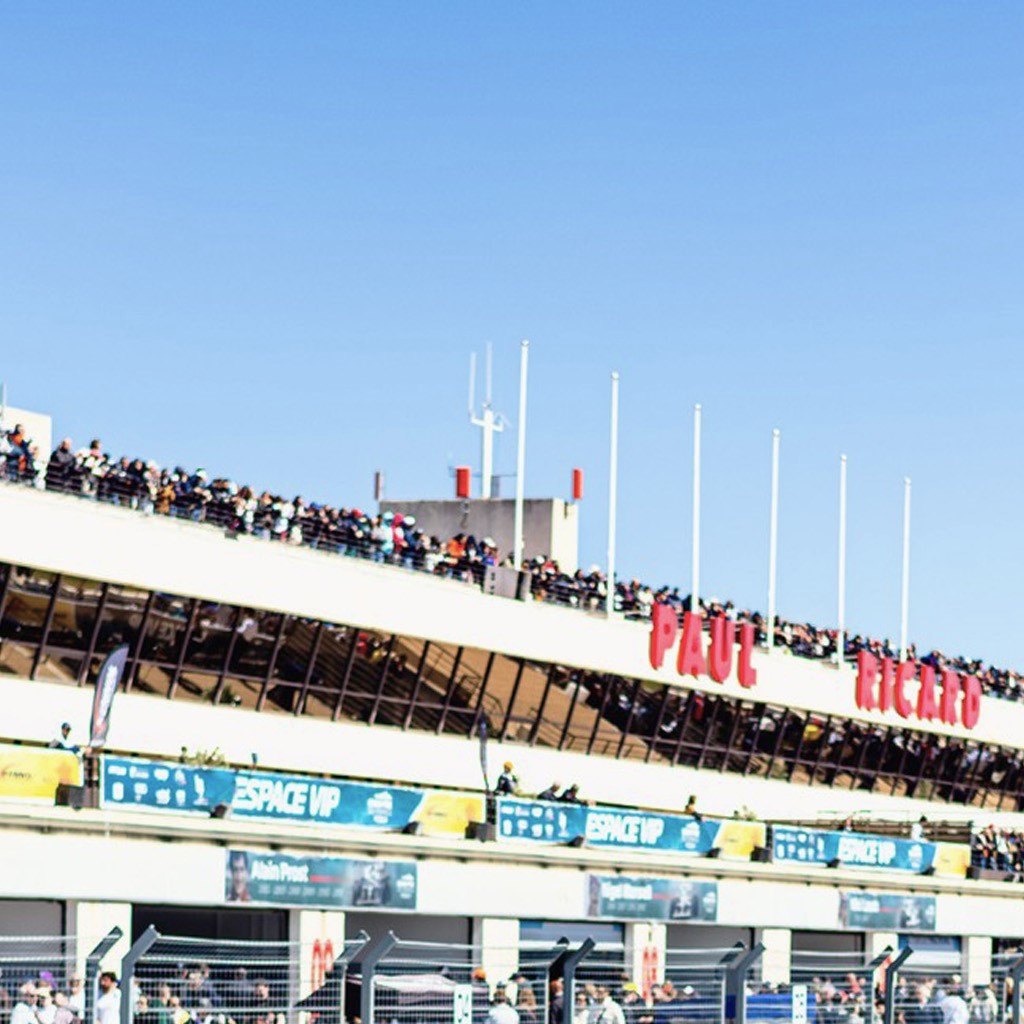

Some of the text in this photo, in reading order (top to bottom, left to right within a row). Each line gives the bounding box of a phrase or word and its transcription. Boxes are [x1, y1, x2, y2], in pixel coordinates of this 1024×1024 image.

[648, 602, 982, 729] PAUL RICARD
[231, 775, 308, 815] ESPACE
[309, 784, 341, 817] VIP
